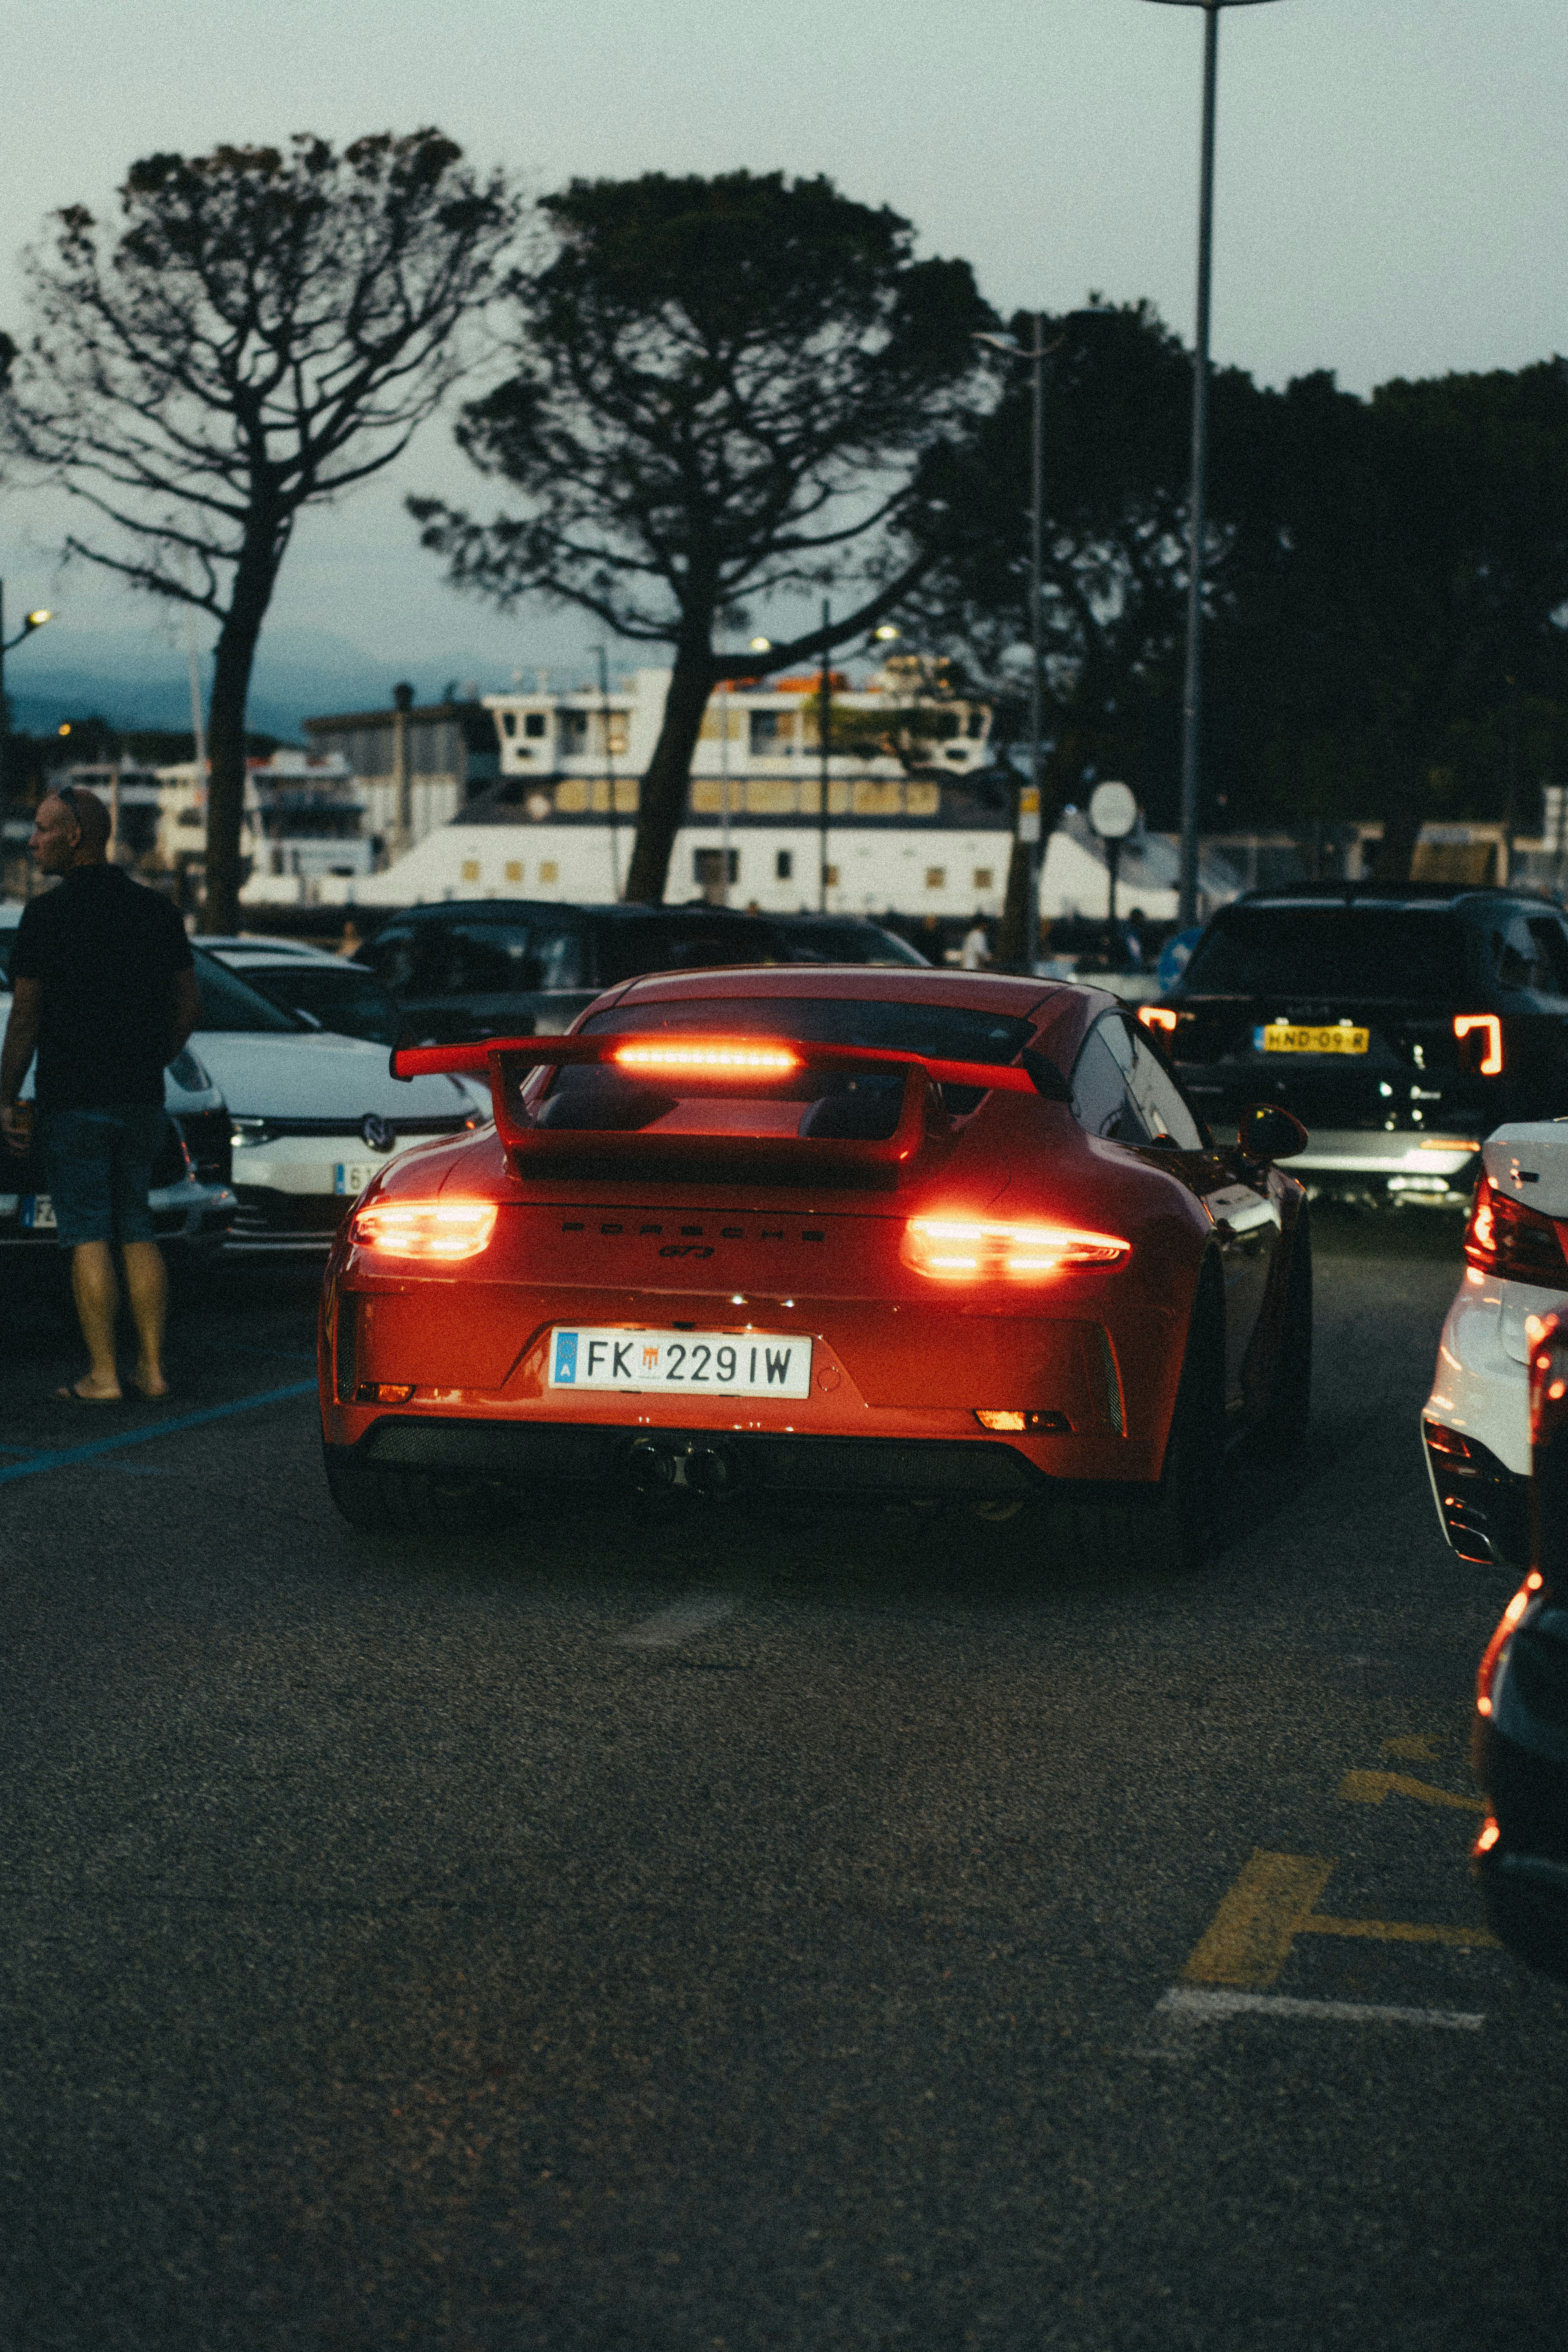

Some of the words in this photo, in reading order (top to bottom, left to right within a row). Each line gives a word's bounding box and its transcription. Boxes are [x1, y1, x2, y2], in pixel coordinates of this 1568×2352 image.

[561, 1222, 825, 1242] PORSCHE
[659, 1245, 715, 1259] GT3
[561, 1364, 570, 1377] A
[588, 1341, 633, 1378] FK
